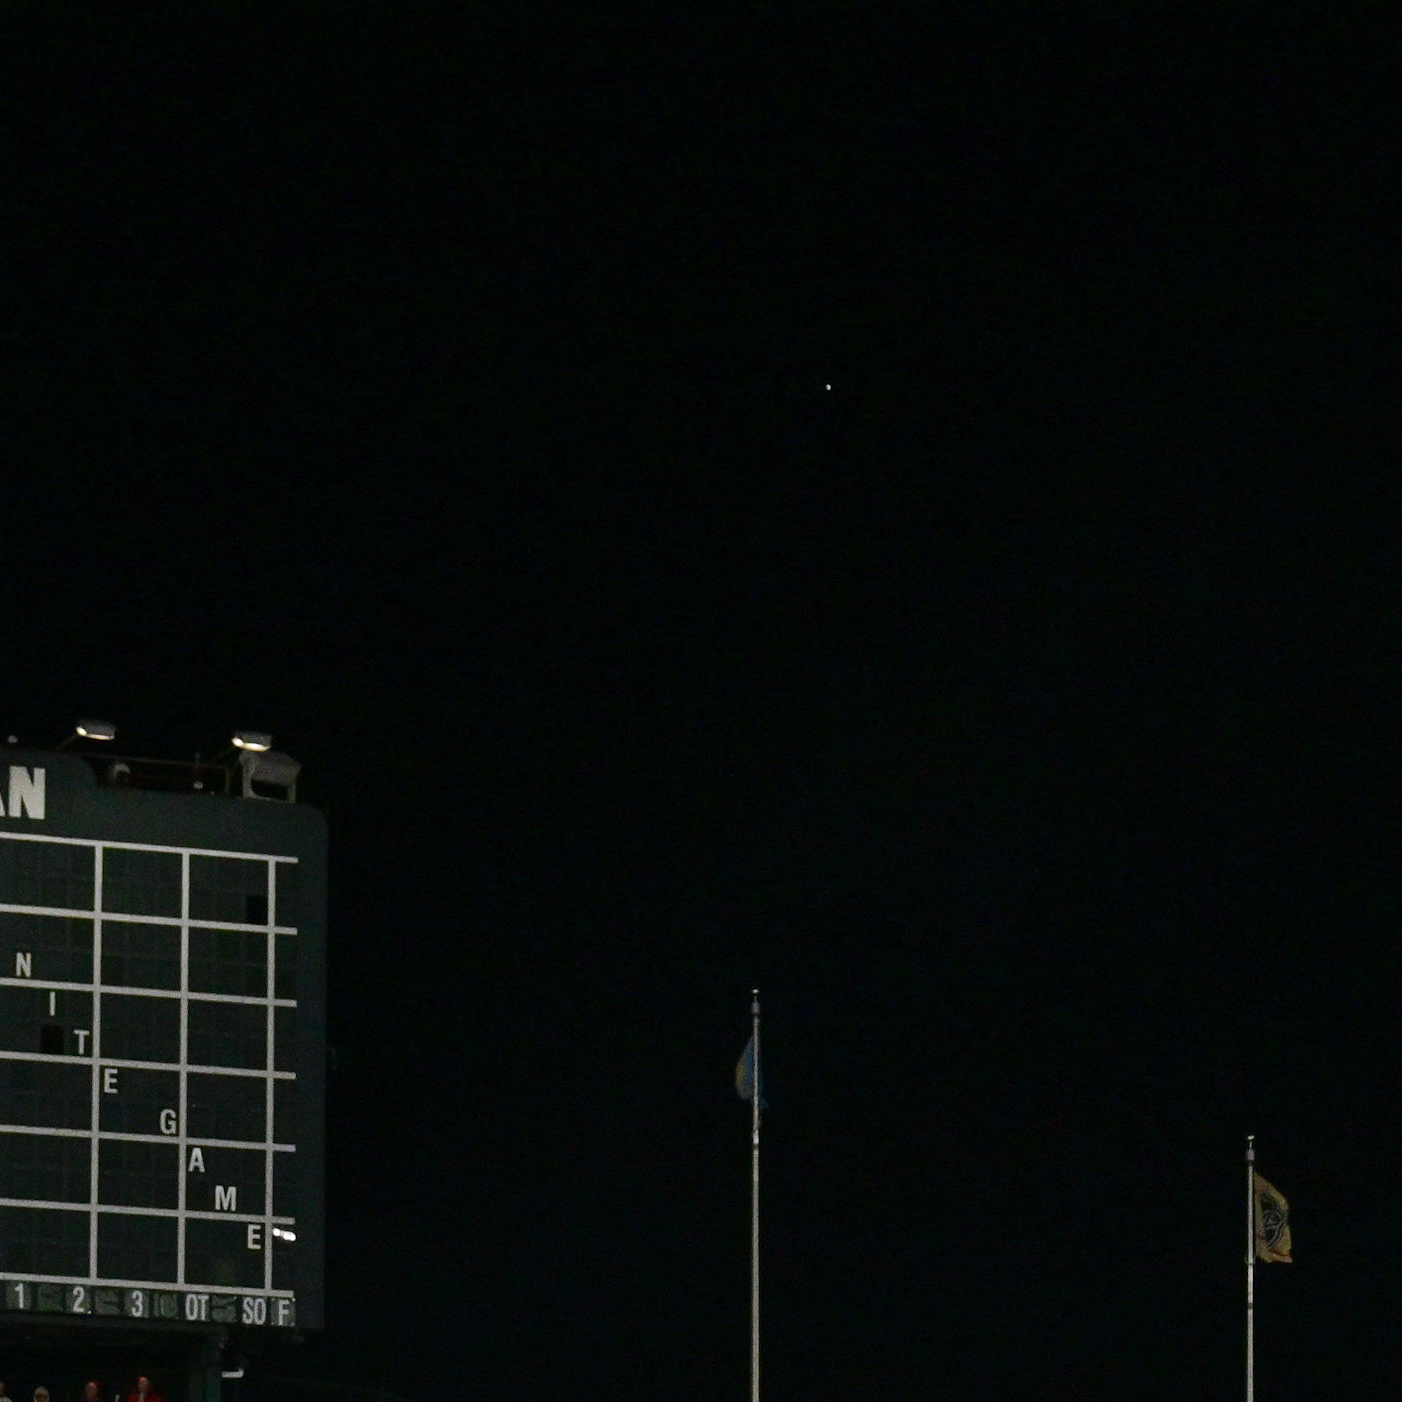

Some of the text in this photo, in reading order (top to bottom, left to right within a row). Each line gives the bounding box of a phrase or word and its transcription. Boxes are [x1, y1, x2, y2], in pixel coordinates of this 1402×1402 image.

[13, 1283, 290, 1325] 1 2 3 OT SO F
